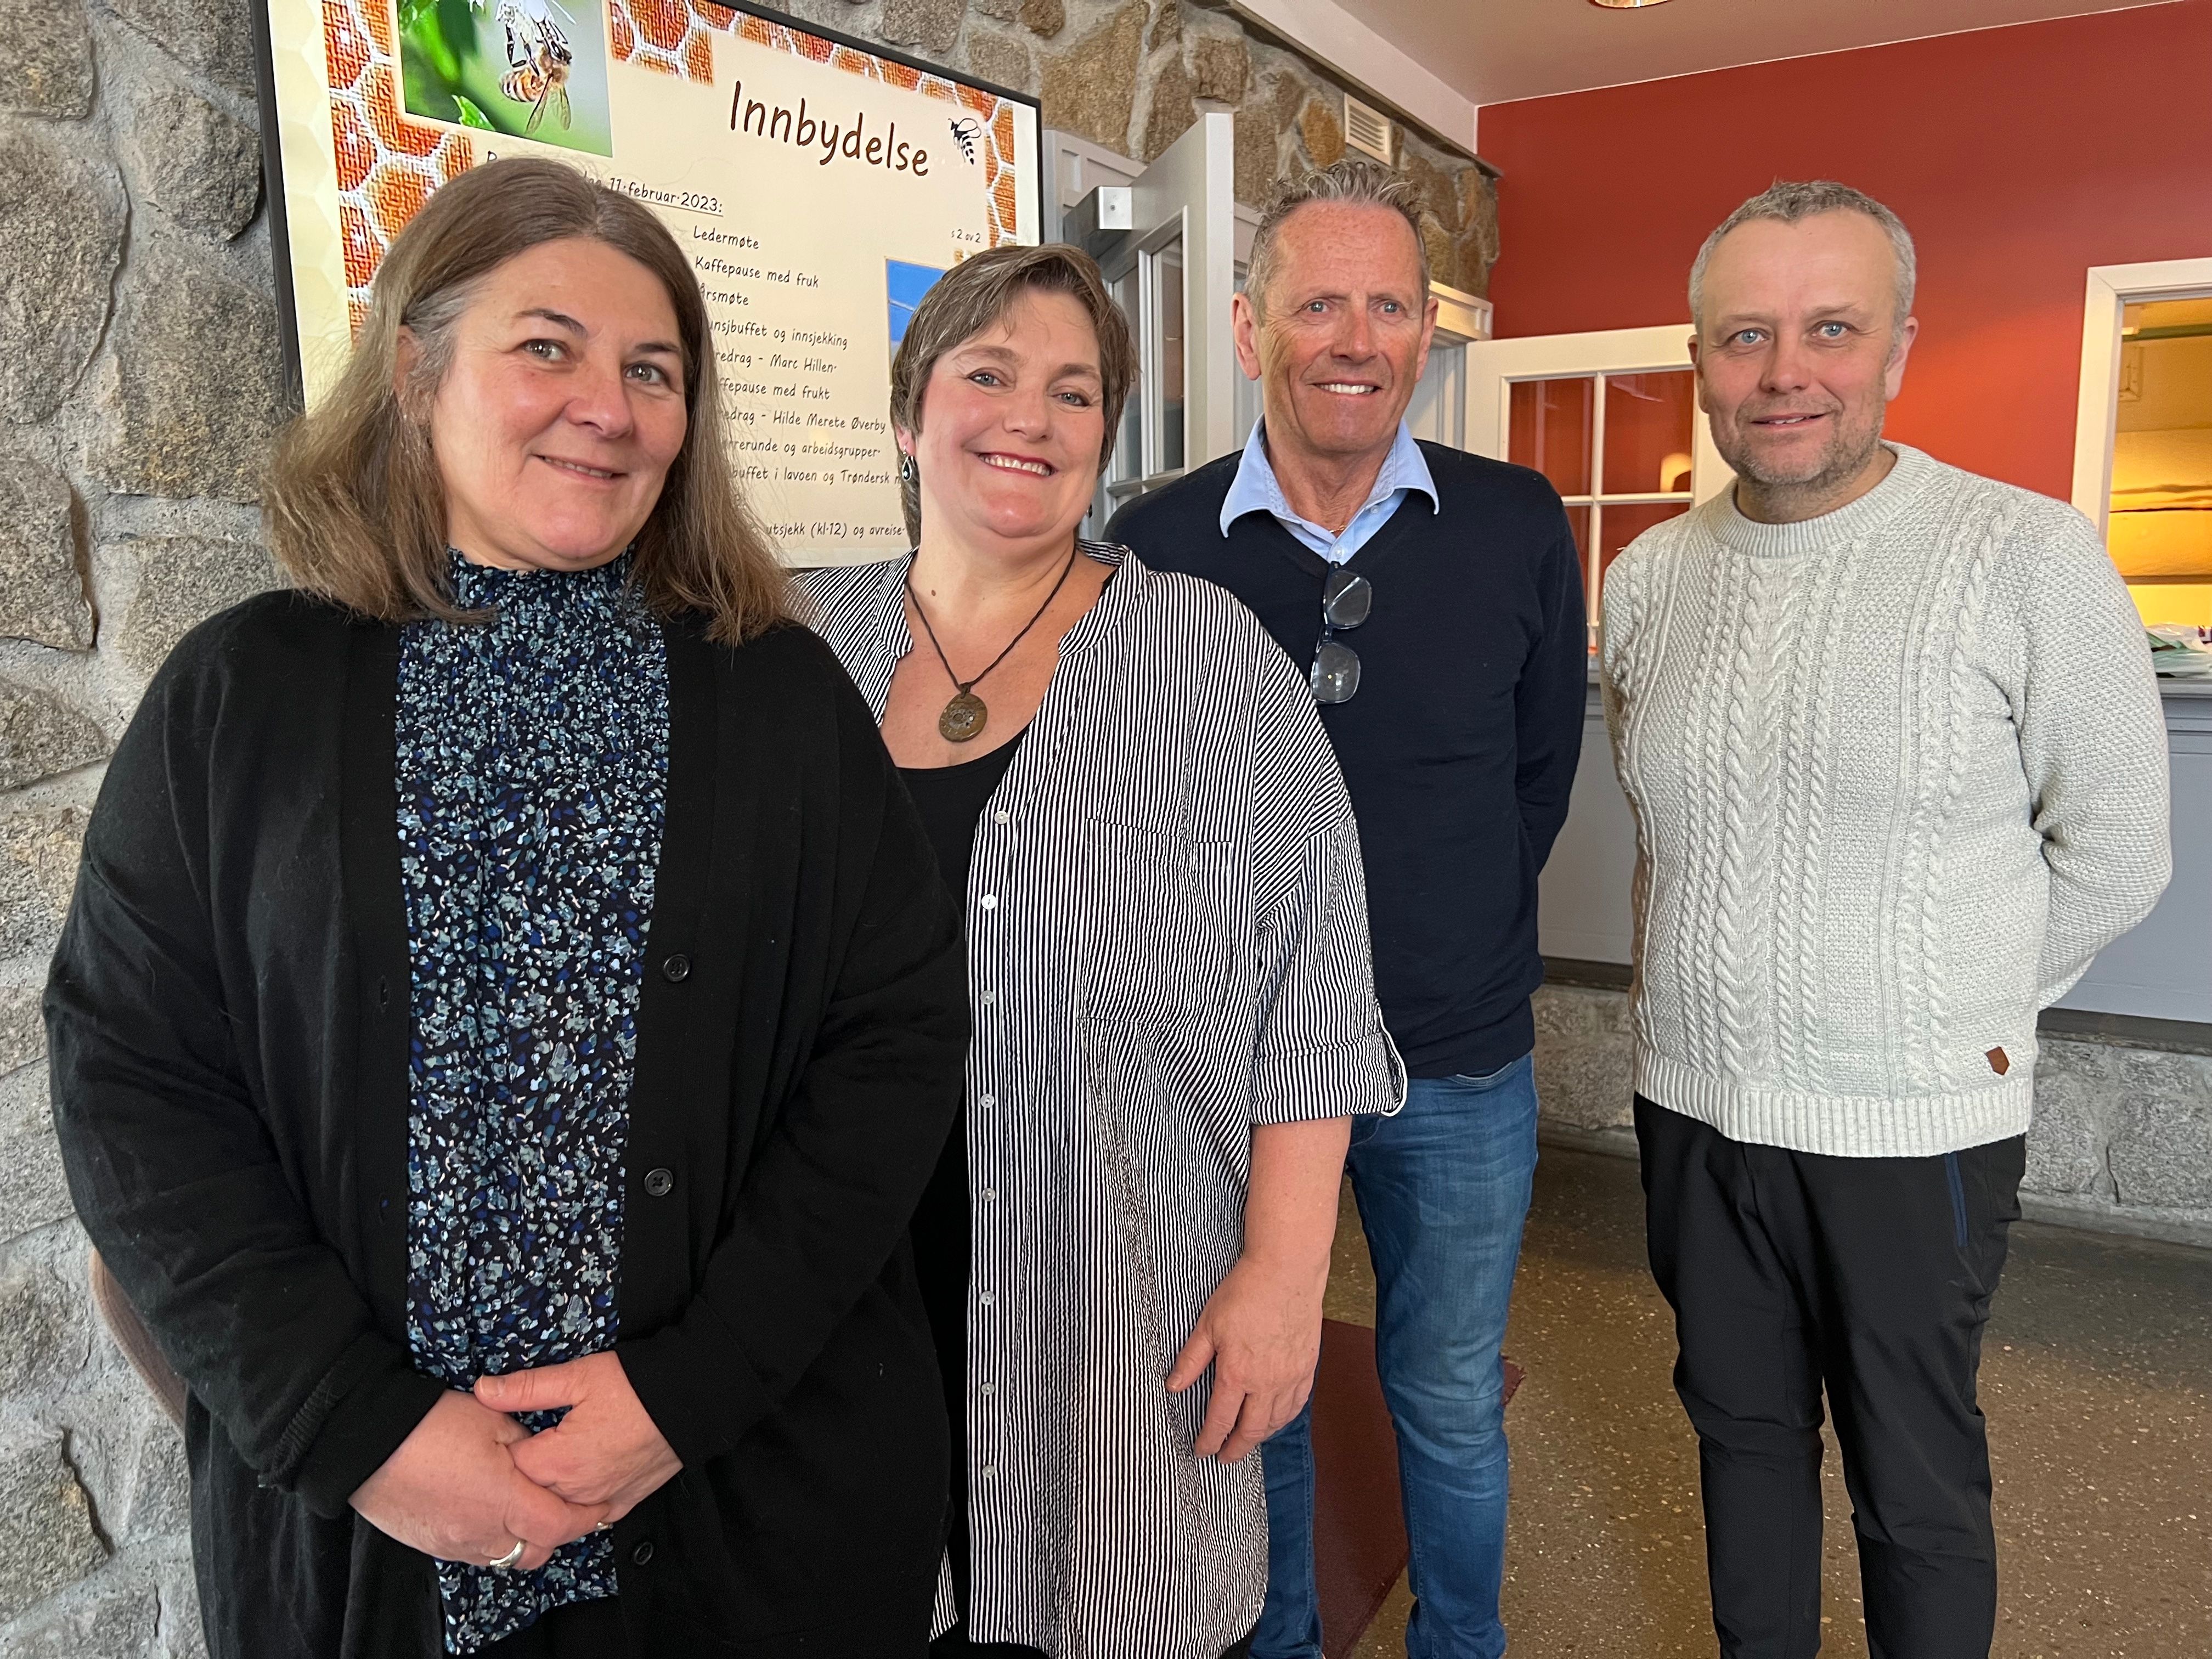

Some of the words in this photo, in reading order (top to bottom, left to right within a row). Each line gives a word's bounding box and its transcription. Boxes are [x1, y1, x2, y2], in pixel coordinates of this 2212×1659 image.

[730, 81, 928, 176] Innbydelse
[693, 225, 759, 249] Ledermøte
[695, 255, 760, 279] Kaffepause
[766, 270, 790, 283] med
[796, 273, 819, 288] fruk
[774, 329, 786, 342] og
[792, 329, 848, 350] innsjekking
[715, 348, 752, 368] redrag
[770, 354, 798, 369] Marc
[719, 377, 766, 396] ffepause
[772, 383, 796, 397] med
[802, 385, 830, 400] frukt
[724, 406, 754, 425] edrag
[773, 410, 800, 425] Hilde
[806, 413, 845, 428] Merete
[851, 416, 886, 434] Øverby
[784, 443, 795, 455] og
[732, 466, 769, 480] buffet
[784, 467, 817, 481] lavoen
[823, 472, 834, 485] og
[840, 470, 890, 484] Trøndersk
[853, 526, 864, 539] og
